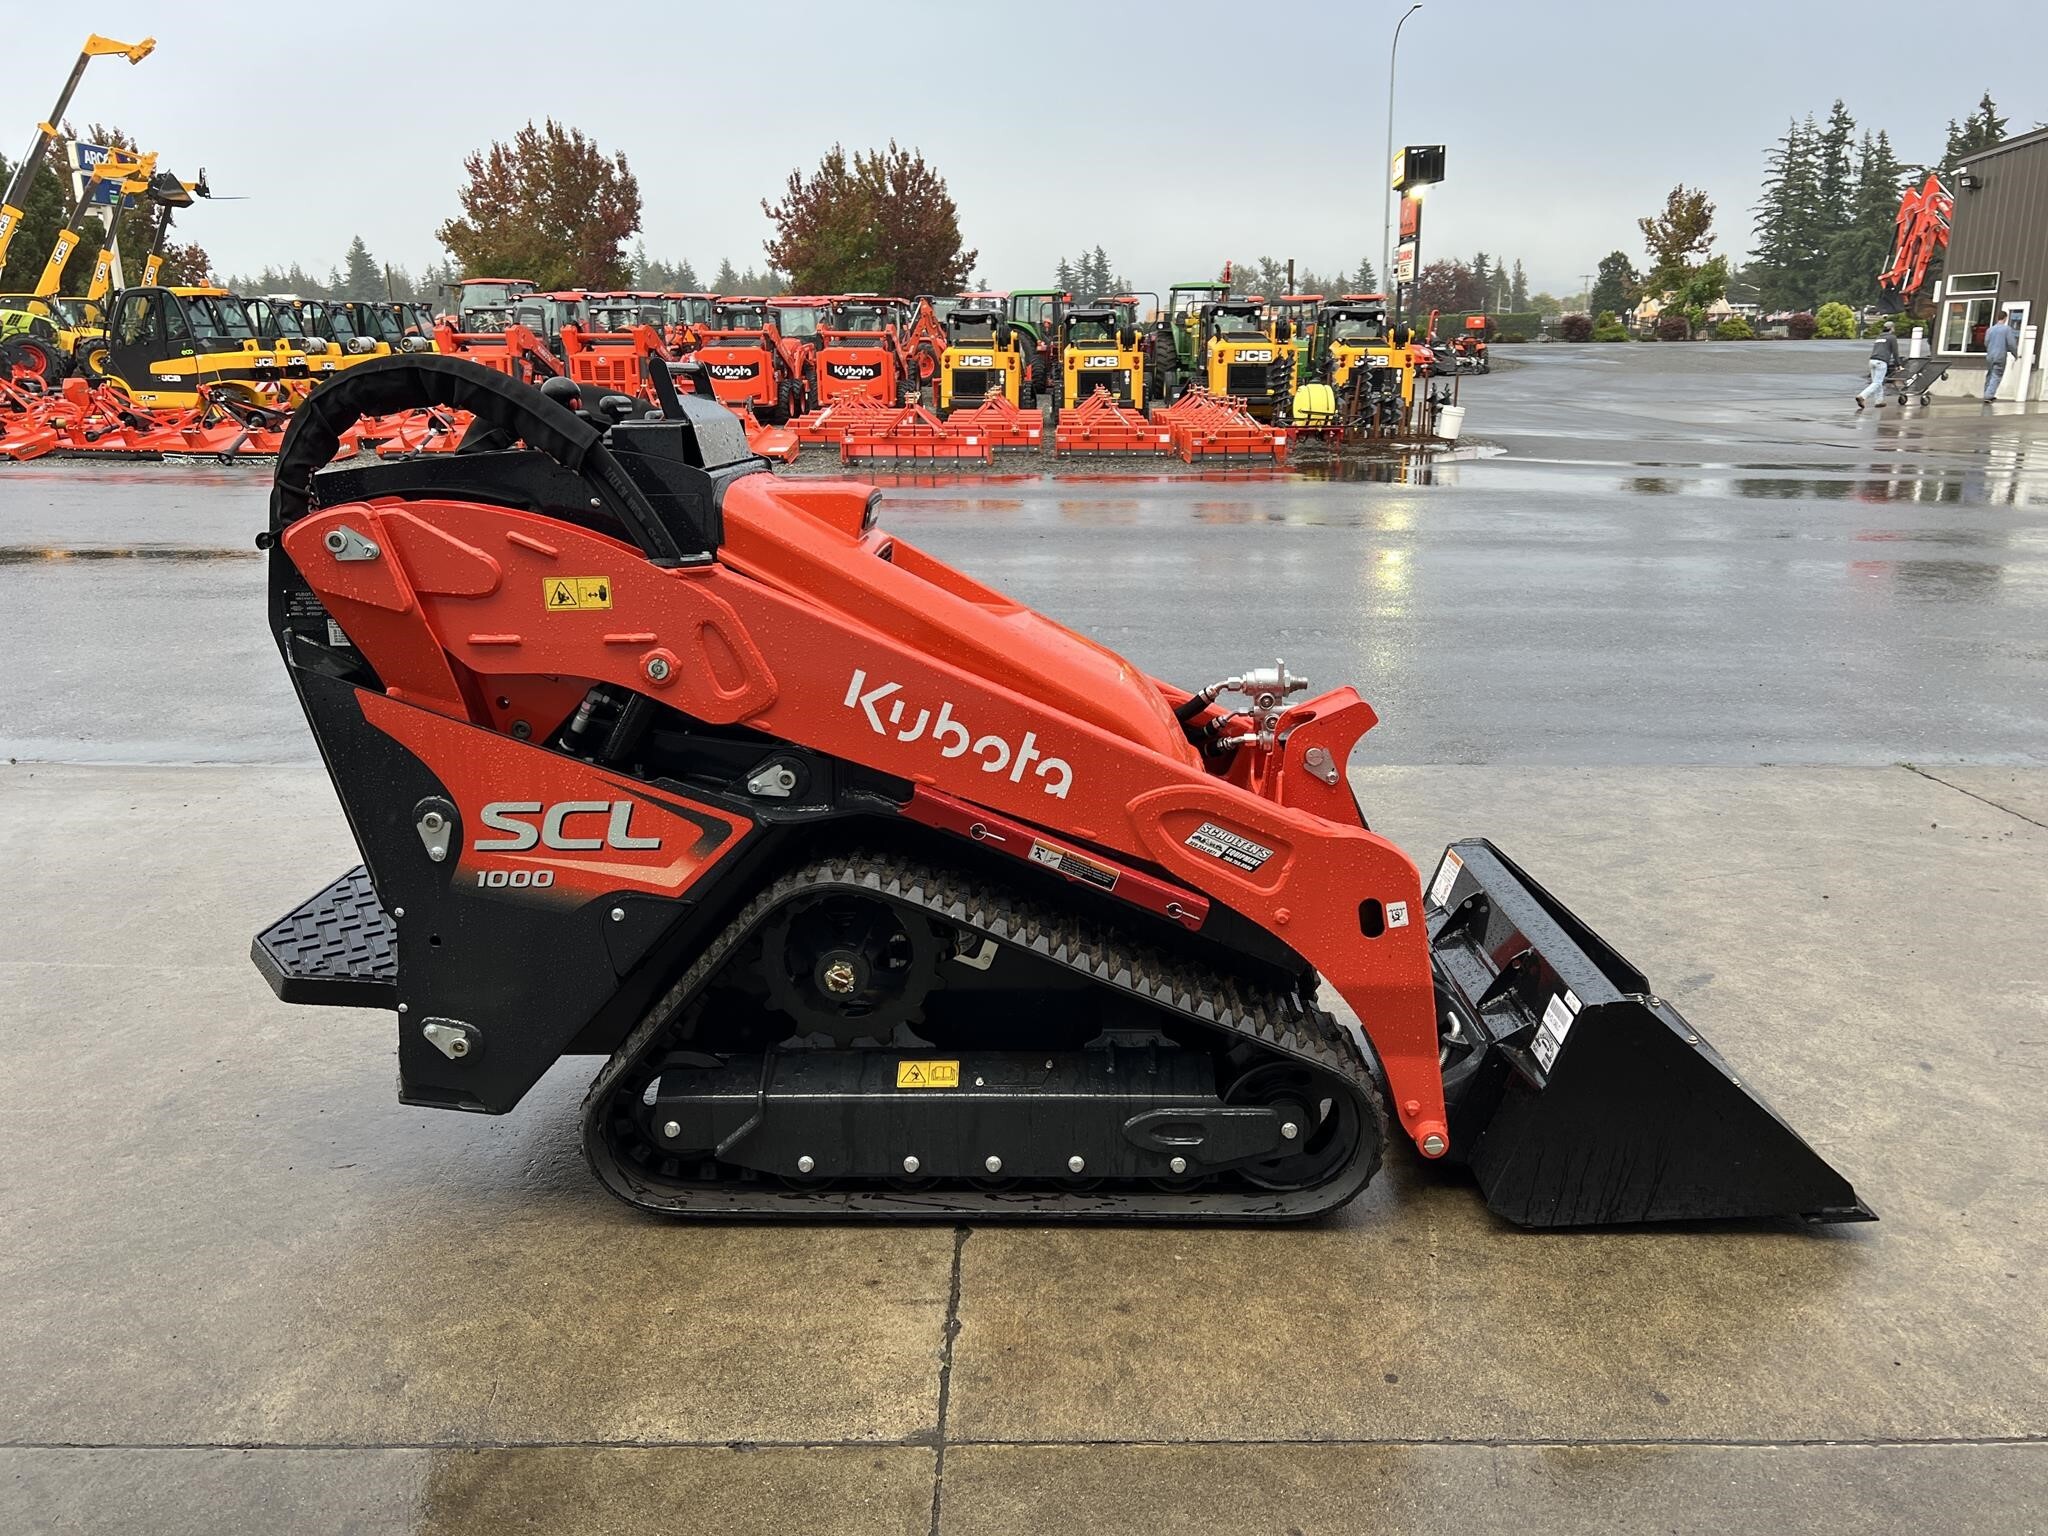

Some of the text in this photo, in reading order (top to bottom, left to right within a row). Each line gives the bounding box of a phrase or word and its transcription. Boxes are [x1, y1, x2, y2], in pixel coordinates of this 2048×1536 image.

[53, 240, 69, 265] JCB
[96, 262, 108, 283] JCB
[145, 266, 156, 286] JCB
[254, 357, 275, 367] JCB
[287, 356, 306, 366] JCB
[959, 356, 993, 366] JCB
[1084, 356, 1119, 367] JCB
[1235, 350, 1273, 362] JCB
[321, 362, 335, 370] JCB
[711, 365, 752, 376] Kubota
[834, 364, 874, 376] Kubota
[843, 668, 1074, 800] Kubota
[473, 800, 661, 850] SCL
[1200, 823, 1270, 859] SCHOLTEN'S
[1225, 847, 1263, 867] EQUIPMENT
[477, 870, 555, 888] 1000
